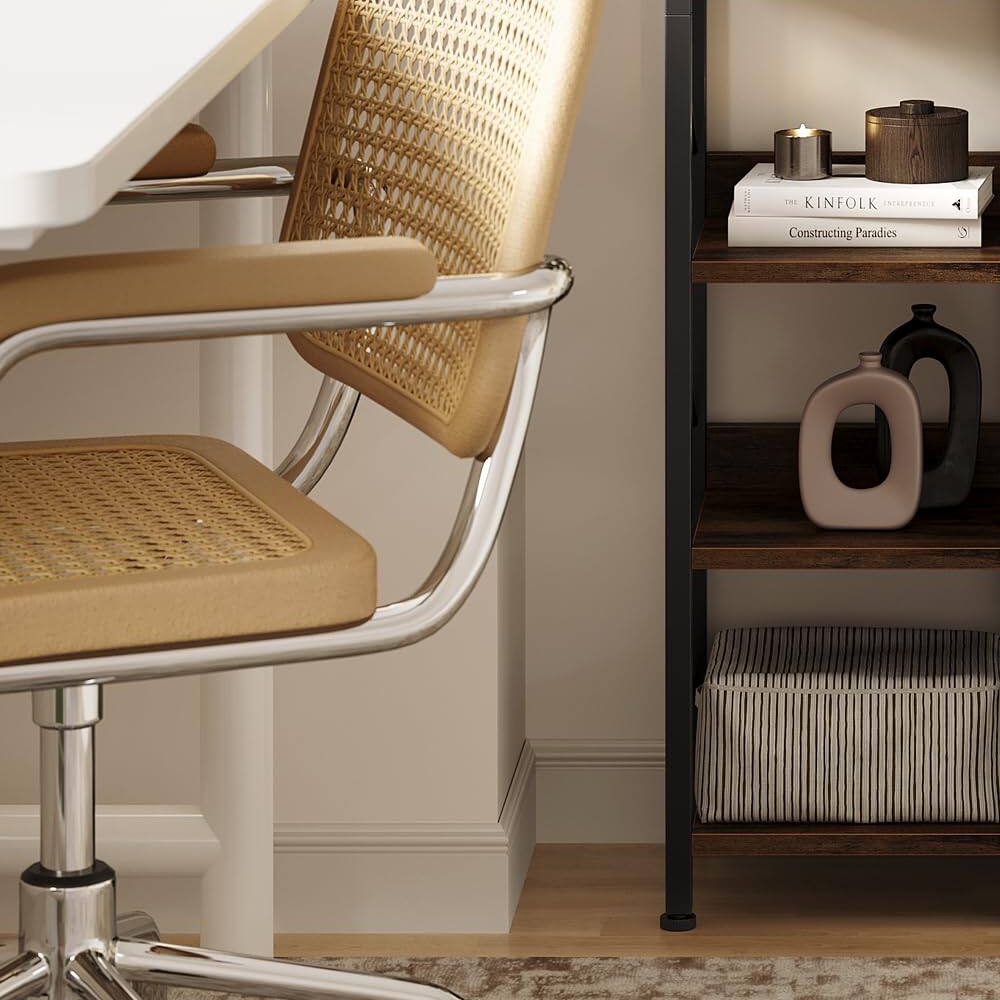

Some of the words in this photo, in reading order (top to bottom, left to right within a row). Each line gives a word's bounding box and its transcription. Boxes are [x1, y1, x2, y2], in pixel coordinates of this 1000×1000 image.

[804, 196, 879, 210] KINFOLK
[789, 226, 853, 241] Constructing
[855, 227, 897, 239] Paradies
